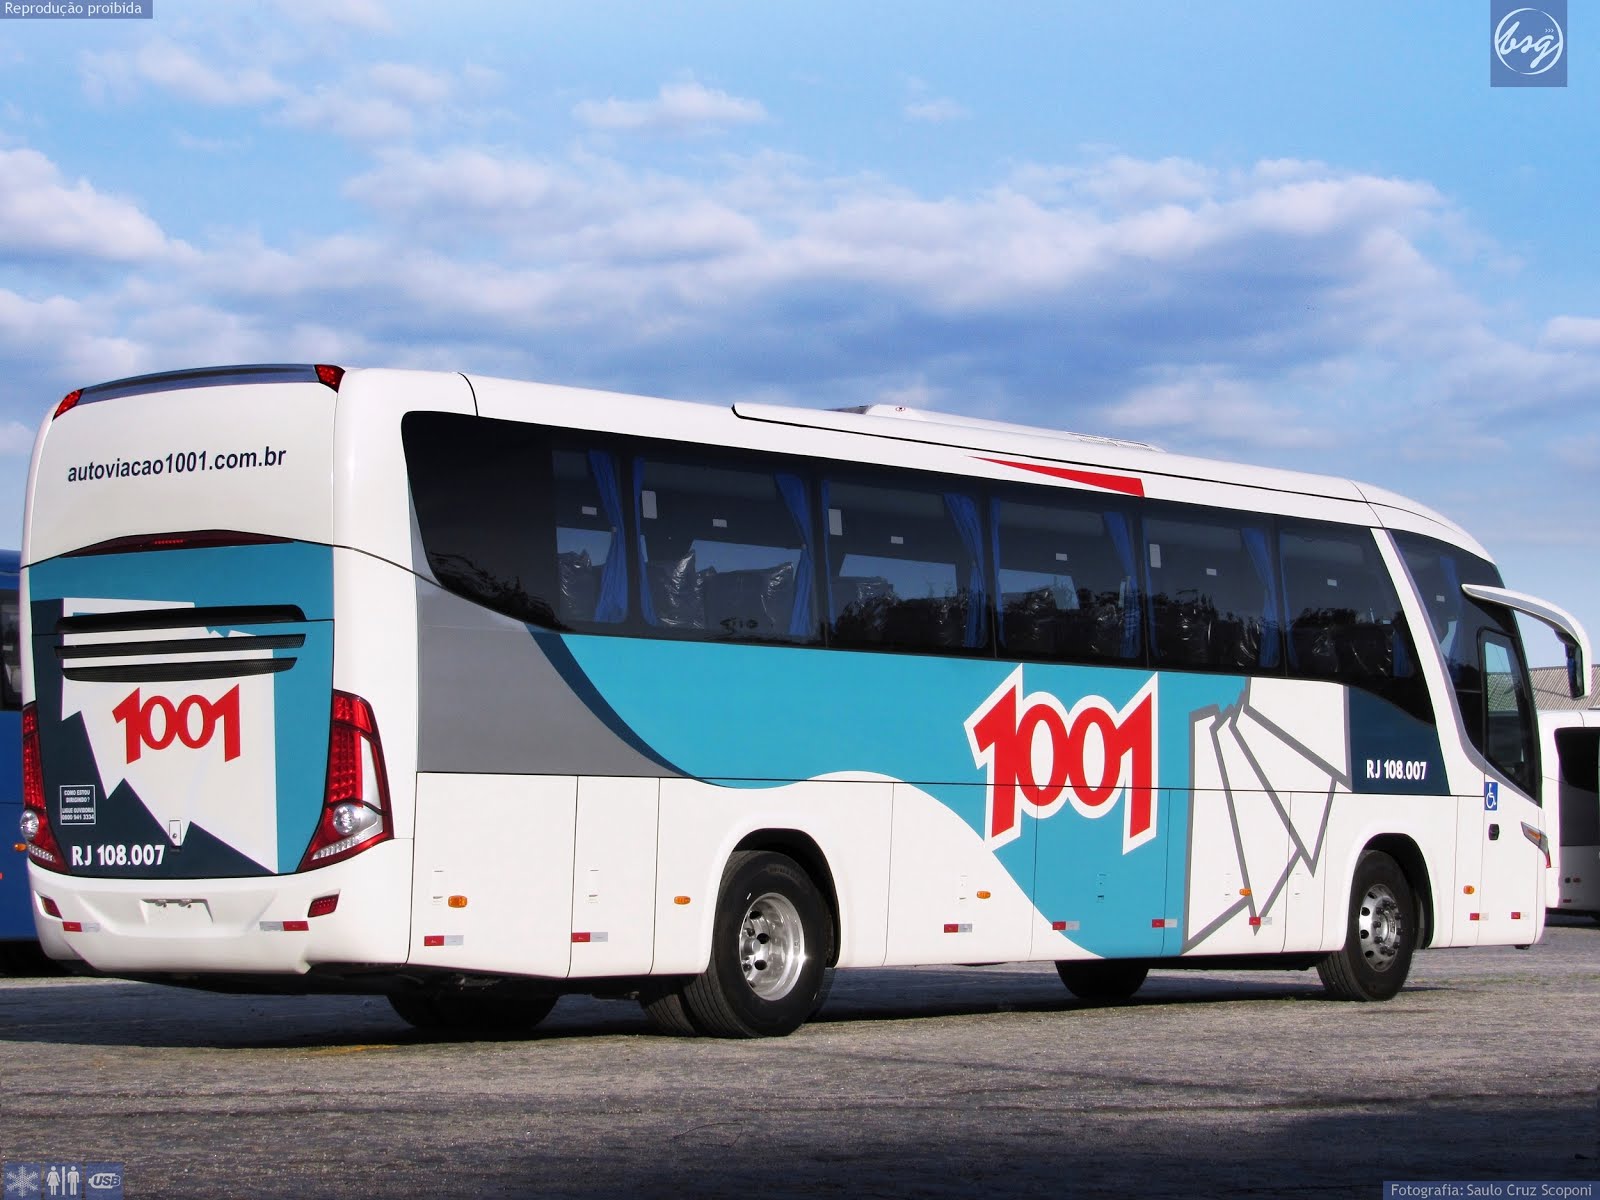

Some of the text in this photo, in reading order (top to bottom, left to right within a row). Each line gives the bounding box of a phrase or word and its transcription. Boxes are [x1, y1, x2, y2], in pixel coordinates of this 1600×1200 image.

[68, 446, 287, 482] autoviacao1001.com.br
[112, 683, 241, 764] 1001
[970, 680, 1154, 842] 1001
[1366, 759, 1427, 780] RJ 108.007
[72, 843, 165, 866] RJ 108.007
